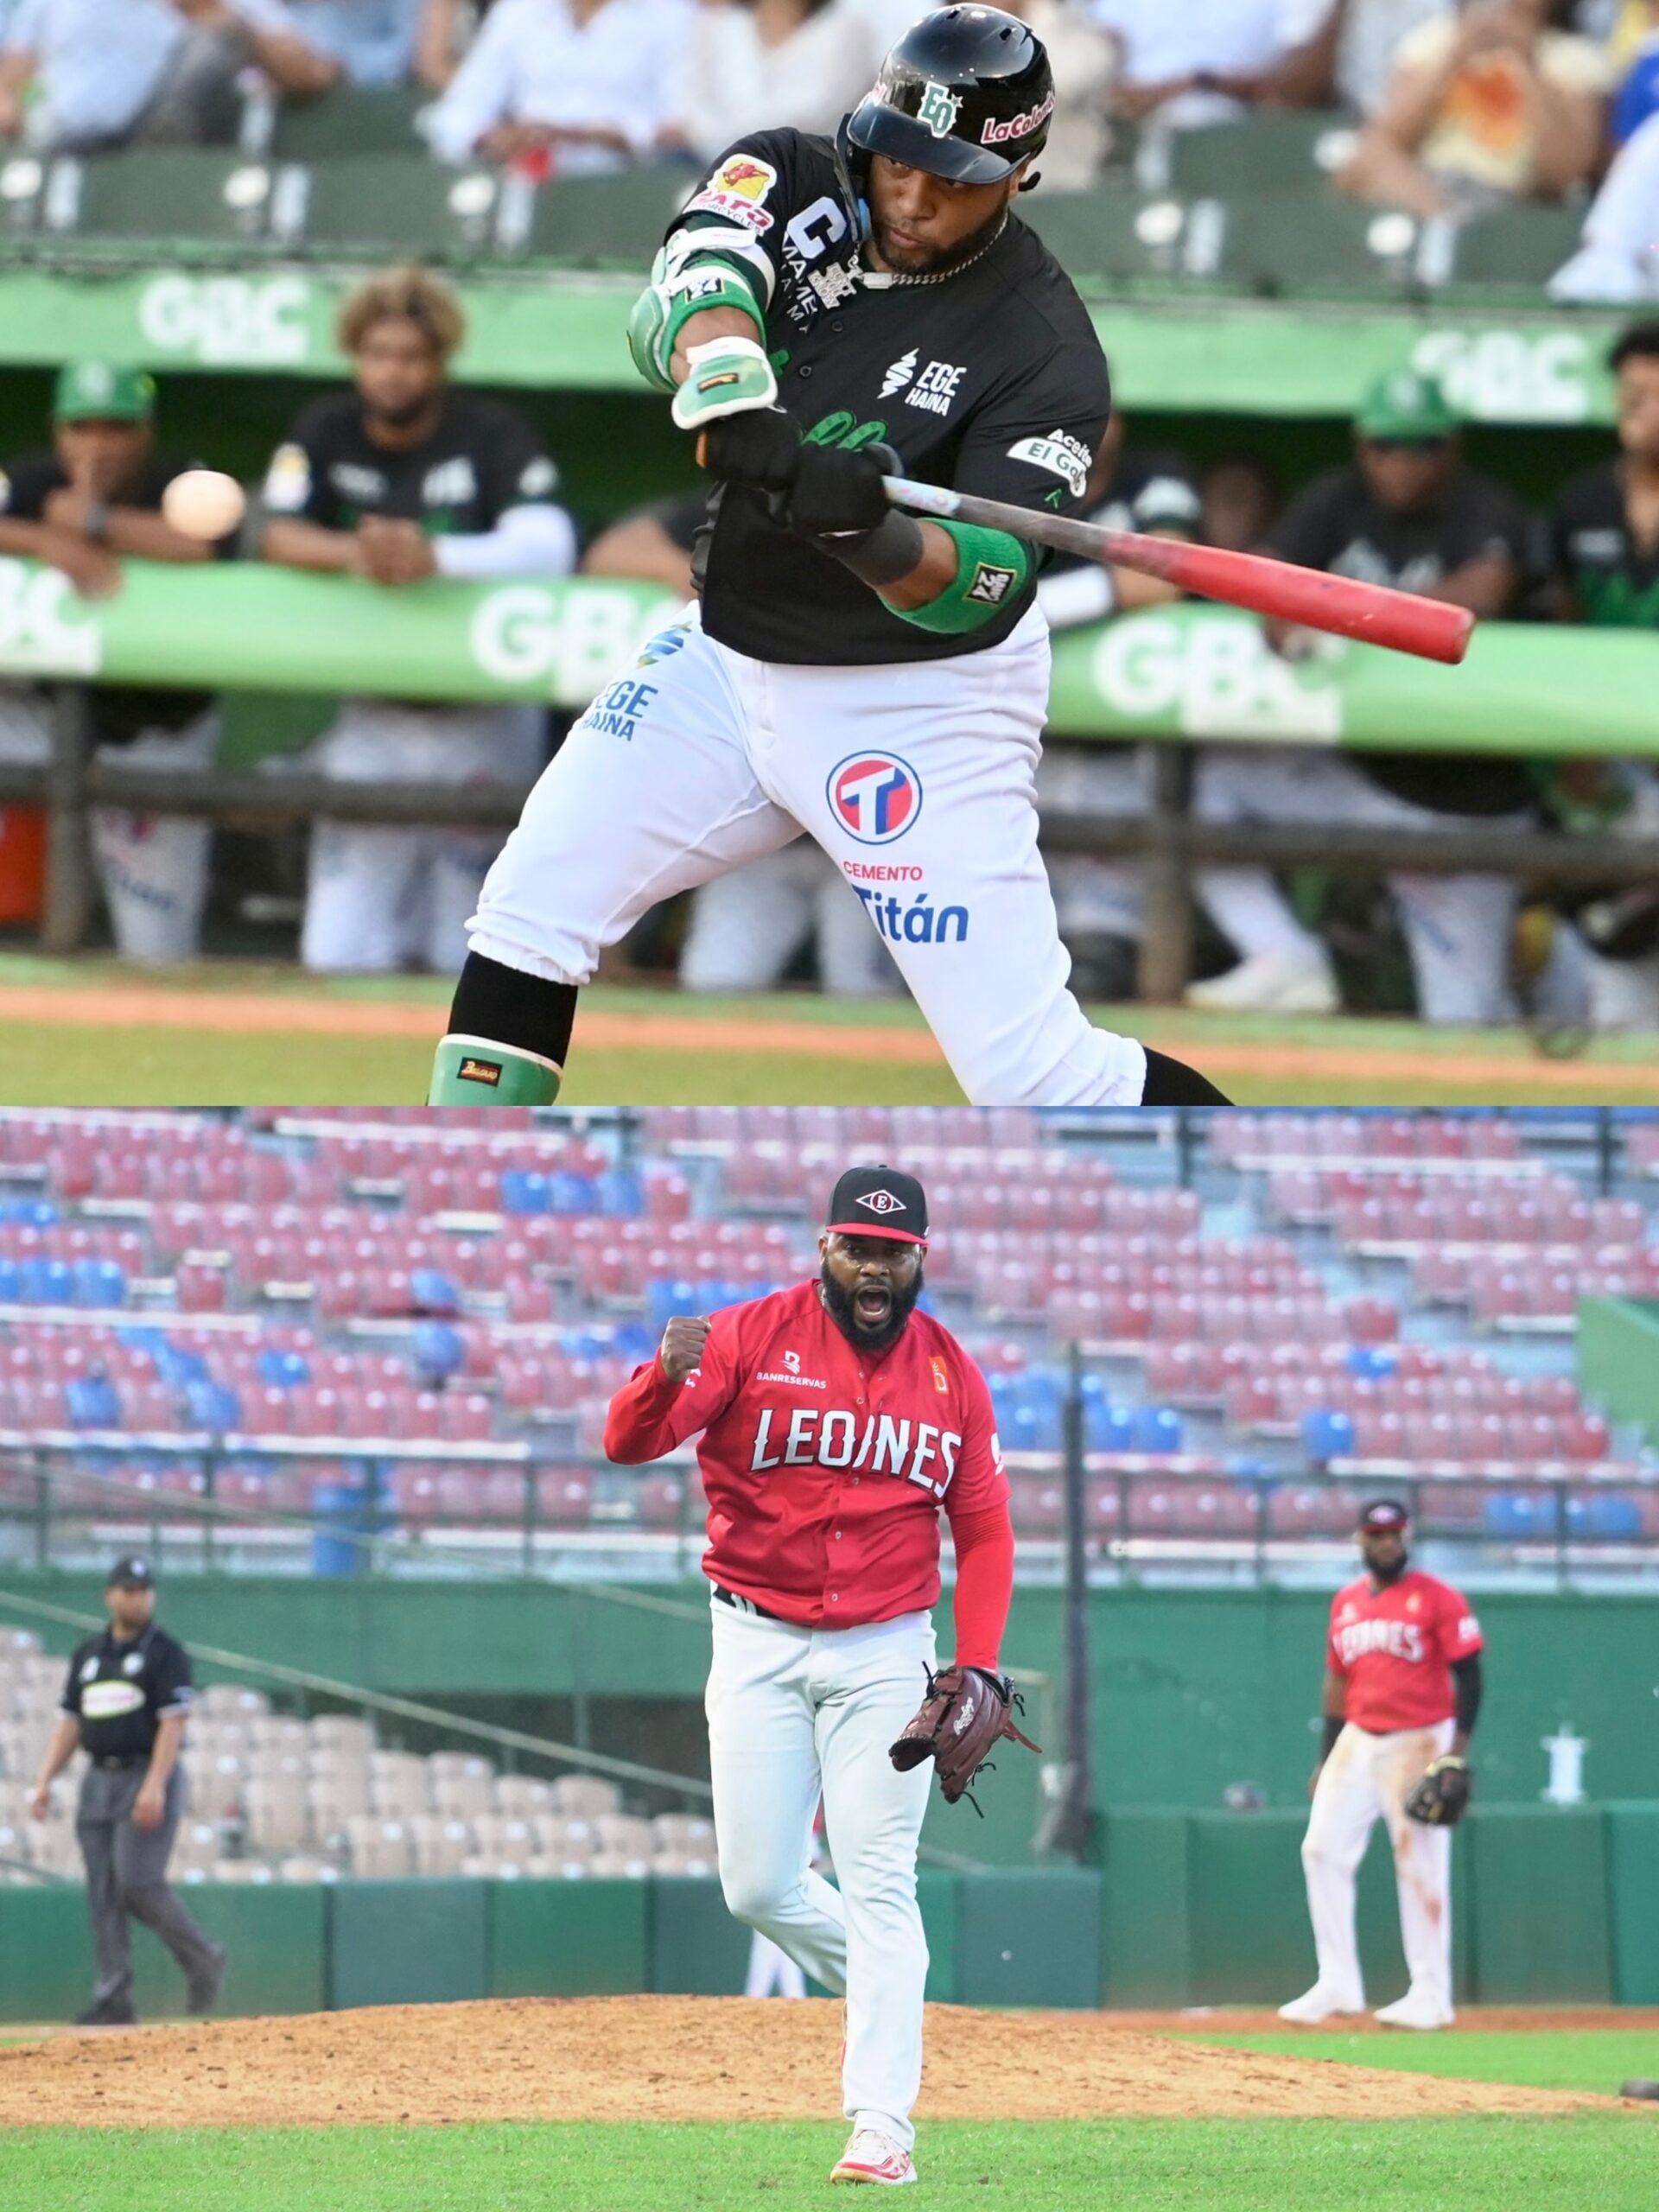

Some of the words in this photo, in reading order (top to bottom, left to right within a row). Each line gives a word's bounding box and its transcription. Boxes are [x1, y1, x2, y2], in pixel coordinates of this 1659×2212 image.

[916, 360, 967, 397] EGE
[904, 386, 951, 416] HAINA
[1027, 442, 1052, 461] El
[1046, 428, 1093, 467] Aceite
[843, 861, 923, 881] CEMENTO
[876, 1195, 887, 1209] E
[756, 1371, 826, 1389] BANRESERVAS
[748, 1408, 963, 1499] LEONES
